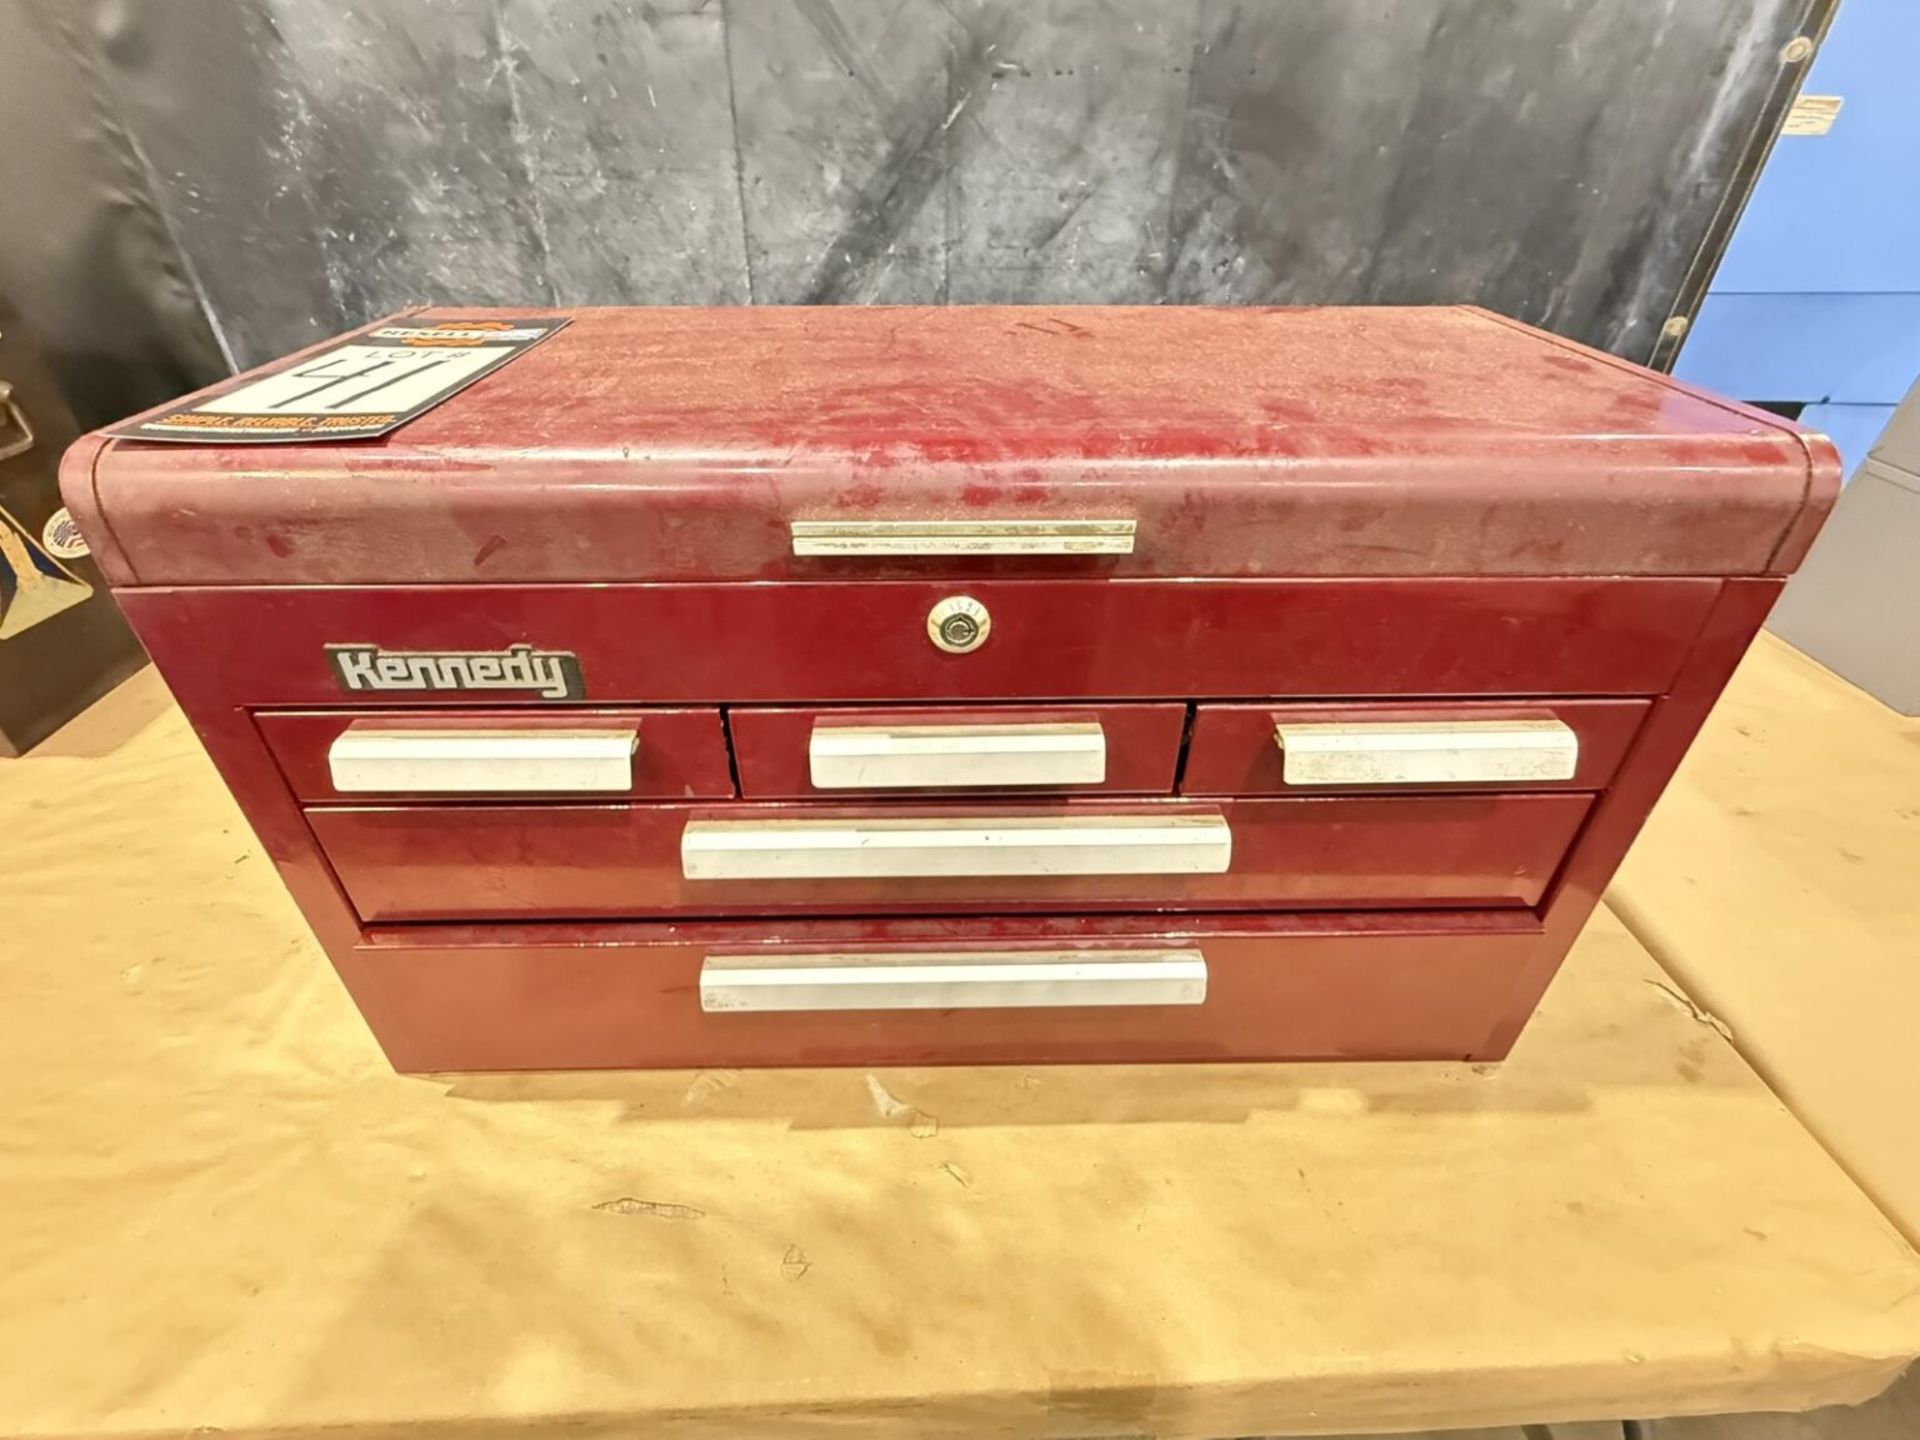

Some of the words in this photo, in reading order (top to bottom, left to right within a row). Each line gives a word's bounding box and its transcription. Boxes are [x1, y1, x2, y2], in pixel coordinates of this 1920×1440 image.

[364, 350, 443, 359] LOT
[266, 359, 449, 409] 41
[337, 650, 569, 698] Kennedy
